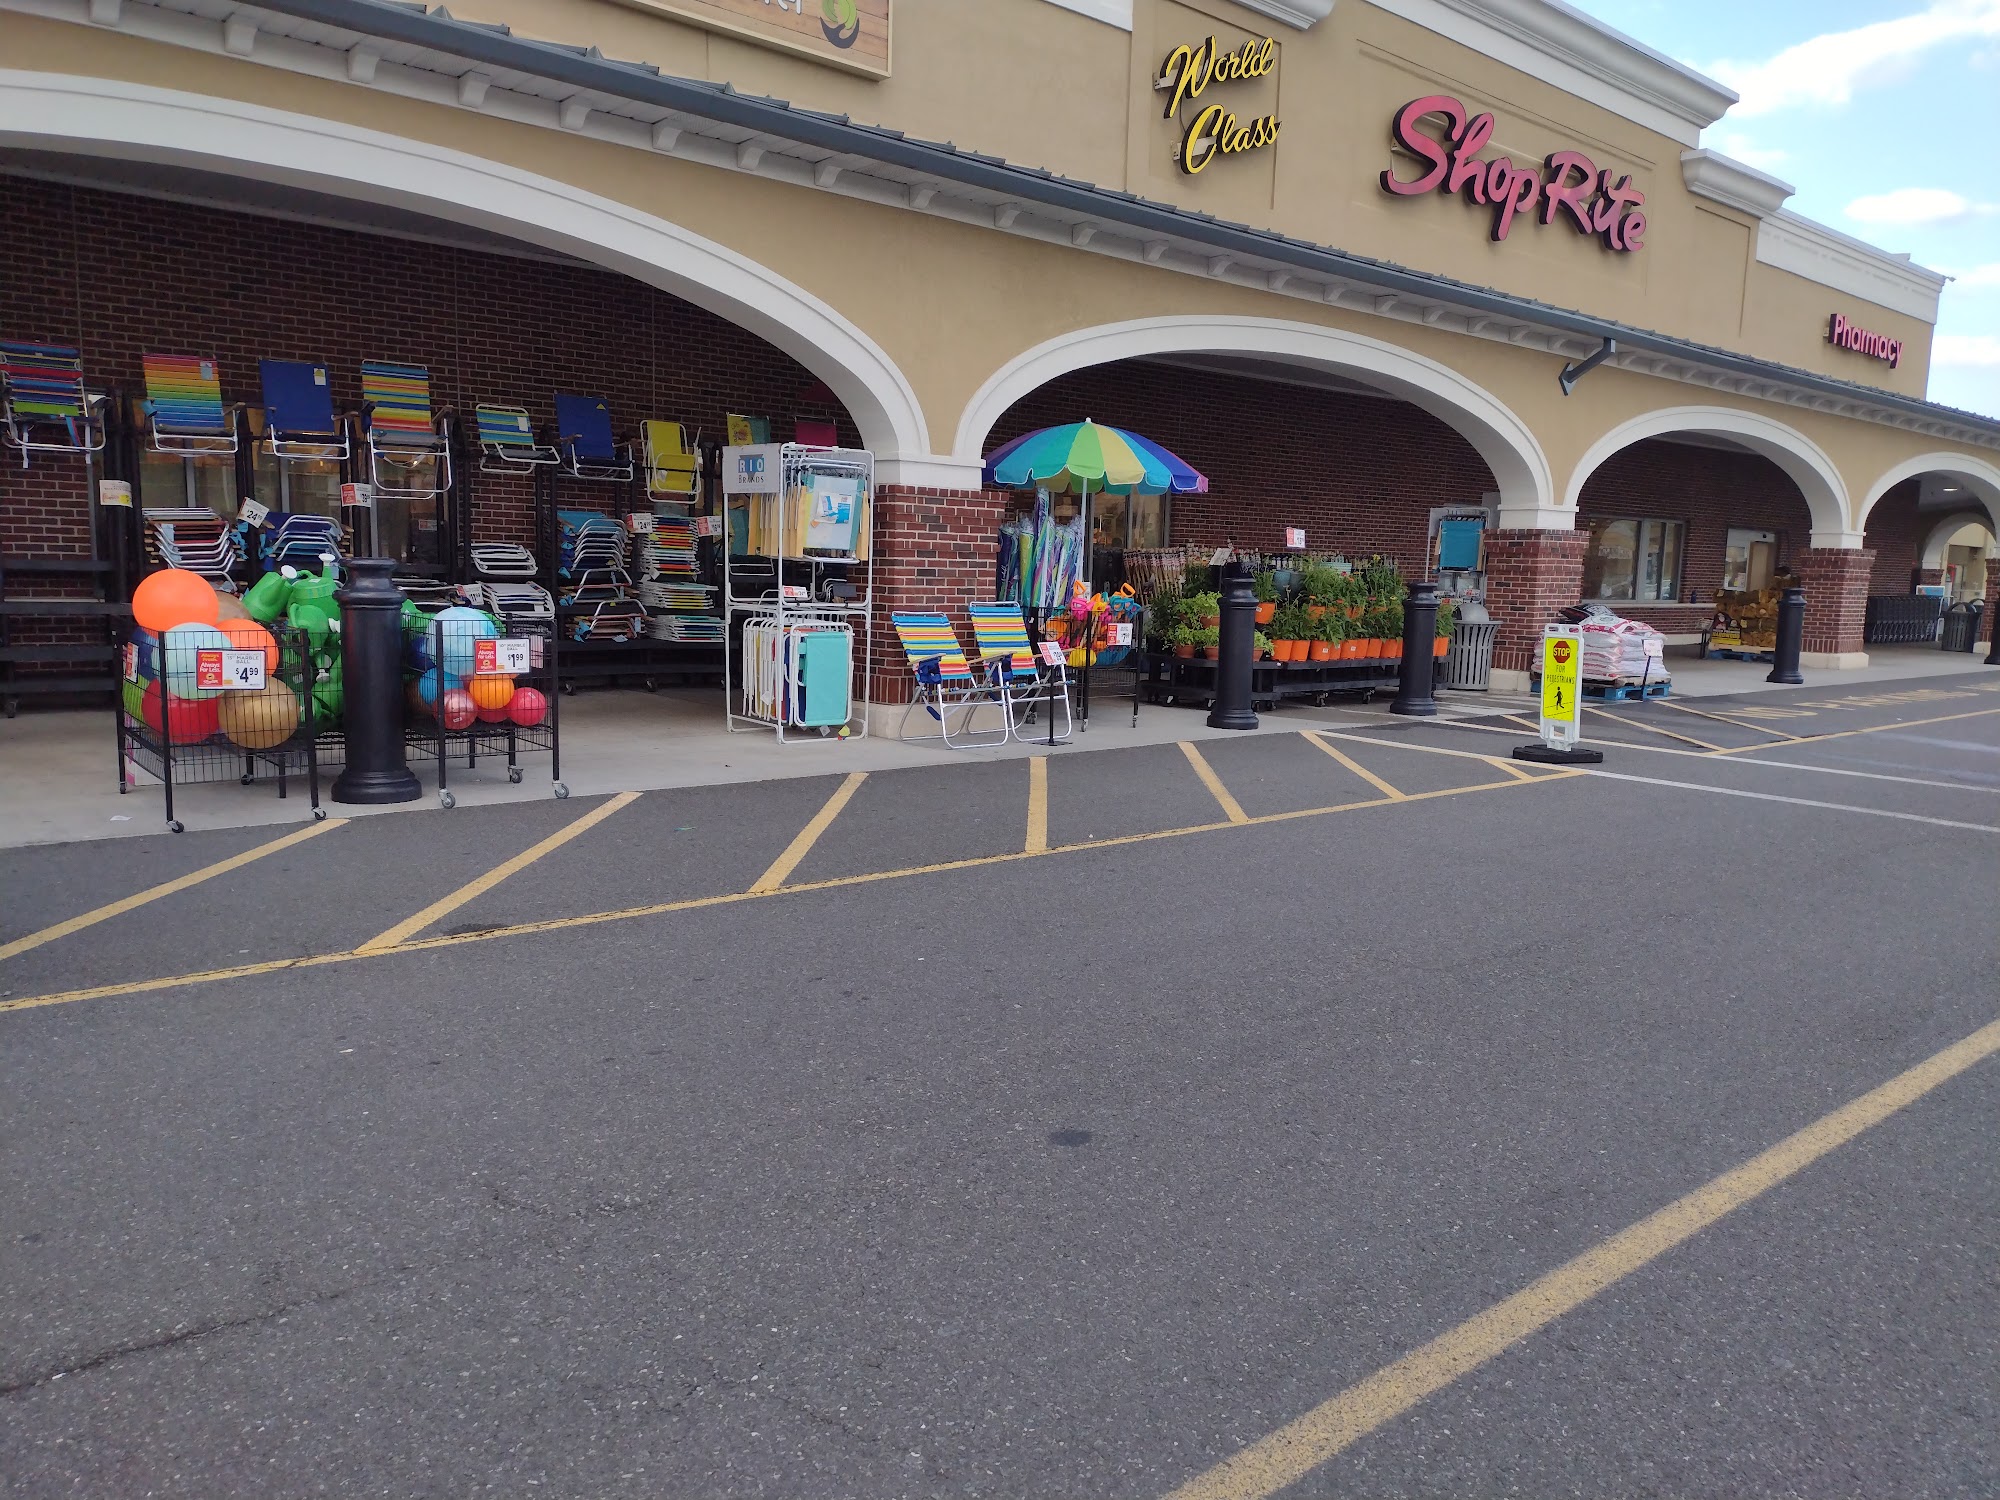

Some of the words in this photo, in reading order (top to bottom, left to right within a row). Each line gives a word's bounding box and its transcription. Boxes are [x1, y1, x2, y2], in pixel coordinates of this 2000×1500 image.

[1160, 35, 1275, 119] World
[1180, 104, 1282, 174] Class
[1380, 95, 1647, 251] ShopRite
[1829, 313, 1904, 369] Pharmacy
[739, 475, 764, 484] BRANDS
[740, 459, 763, 471] RIO
[1554, 648, 1570, 656] STOP
[1547, 675, 1575, 684] PEDESTRIANS
